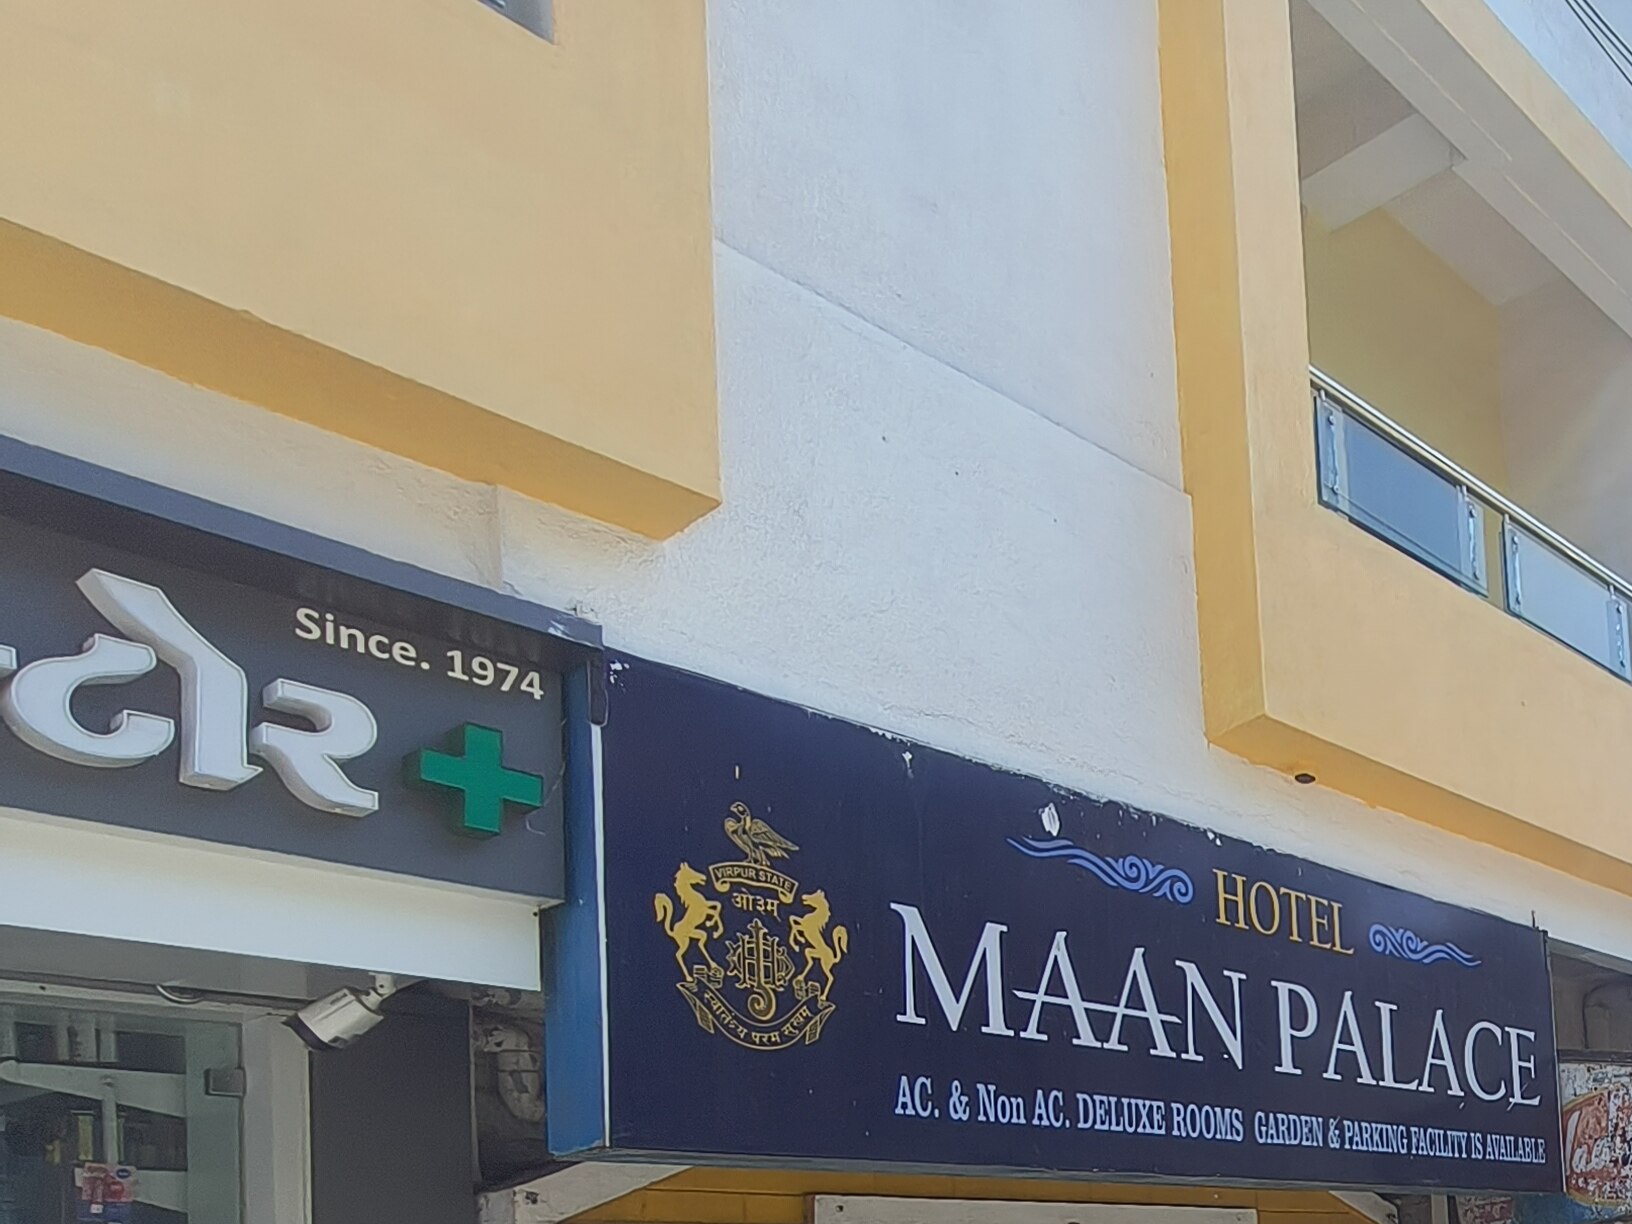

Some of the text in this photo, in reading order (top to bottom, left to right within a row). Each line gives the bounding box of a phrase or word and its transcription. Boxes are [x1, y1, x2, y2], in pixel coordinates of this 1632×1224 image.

[0, 567, 379, 817] ટોર
[294, 606, 545, 700] Since. 1974
[714, 866, 793, 893] VIRPUR STATE
[1212, 868, 1355, 956] HOTEL
[890, 901, 1542, 1107] MAAN PALACE
[895, 1075, 1546, 1164] AC. & Non AC. DELUXE ROOMS GARDEN & PARKING FACILITY IS AVAILABLE
